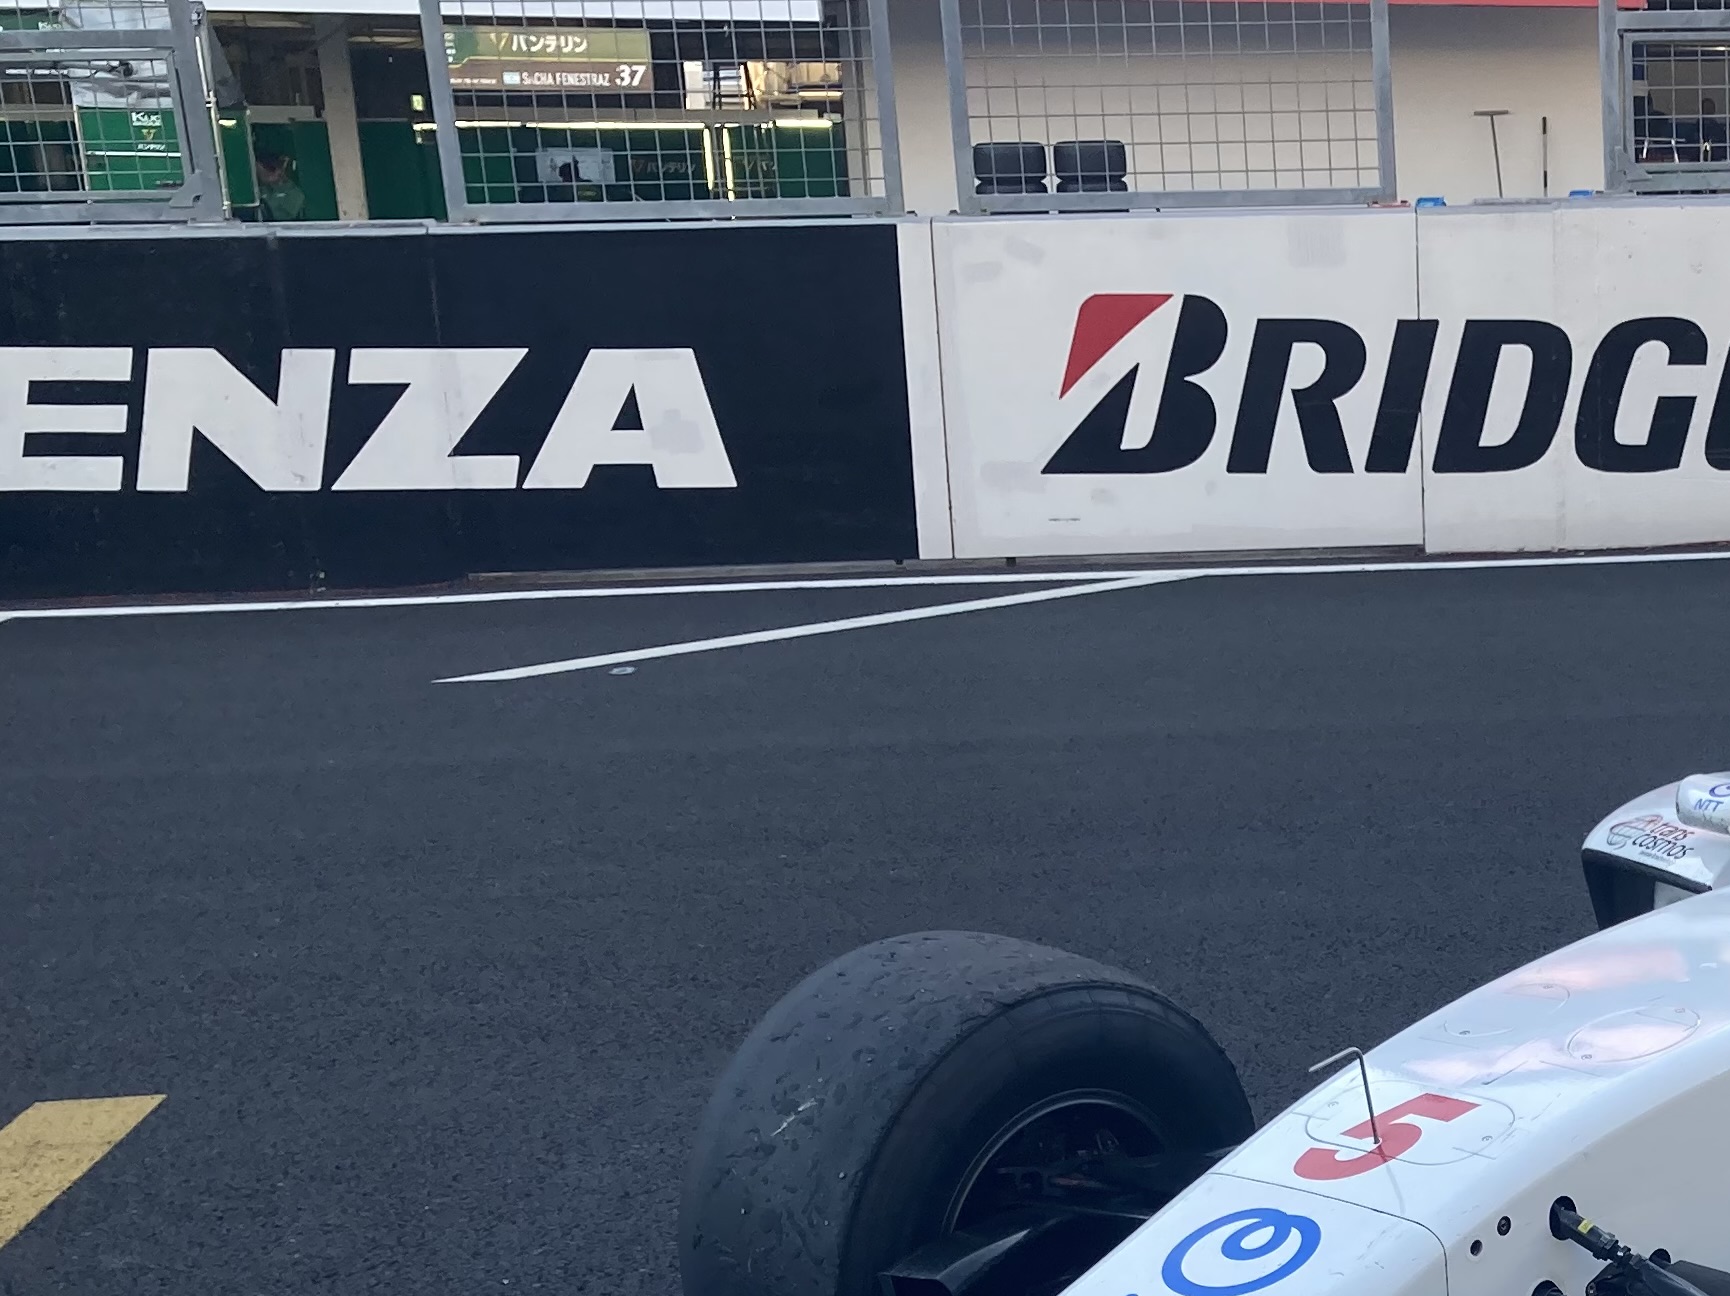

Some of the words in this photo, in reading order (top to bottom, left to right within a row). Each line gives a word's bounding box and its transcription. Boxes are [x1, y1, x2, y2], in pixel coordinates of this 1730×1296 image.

[512, 34, 587, 53] バンテリン
[615, 64, 648, 87] 37
[0, 346, 738, 492] ENZA
[1694, 798, 1725, 812] NTT
[1649, 822, 1695, 842] trans
[1632, 833, 1695, 860] cosmos
[1293, 1092, 1482, 1182] 5
